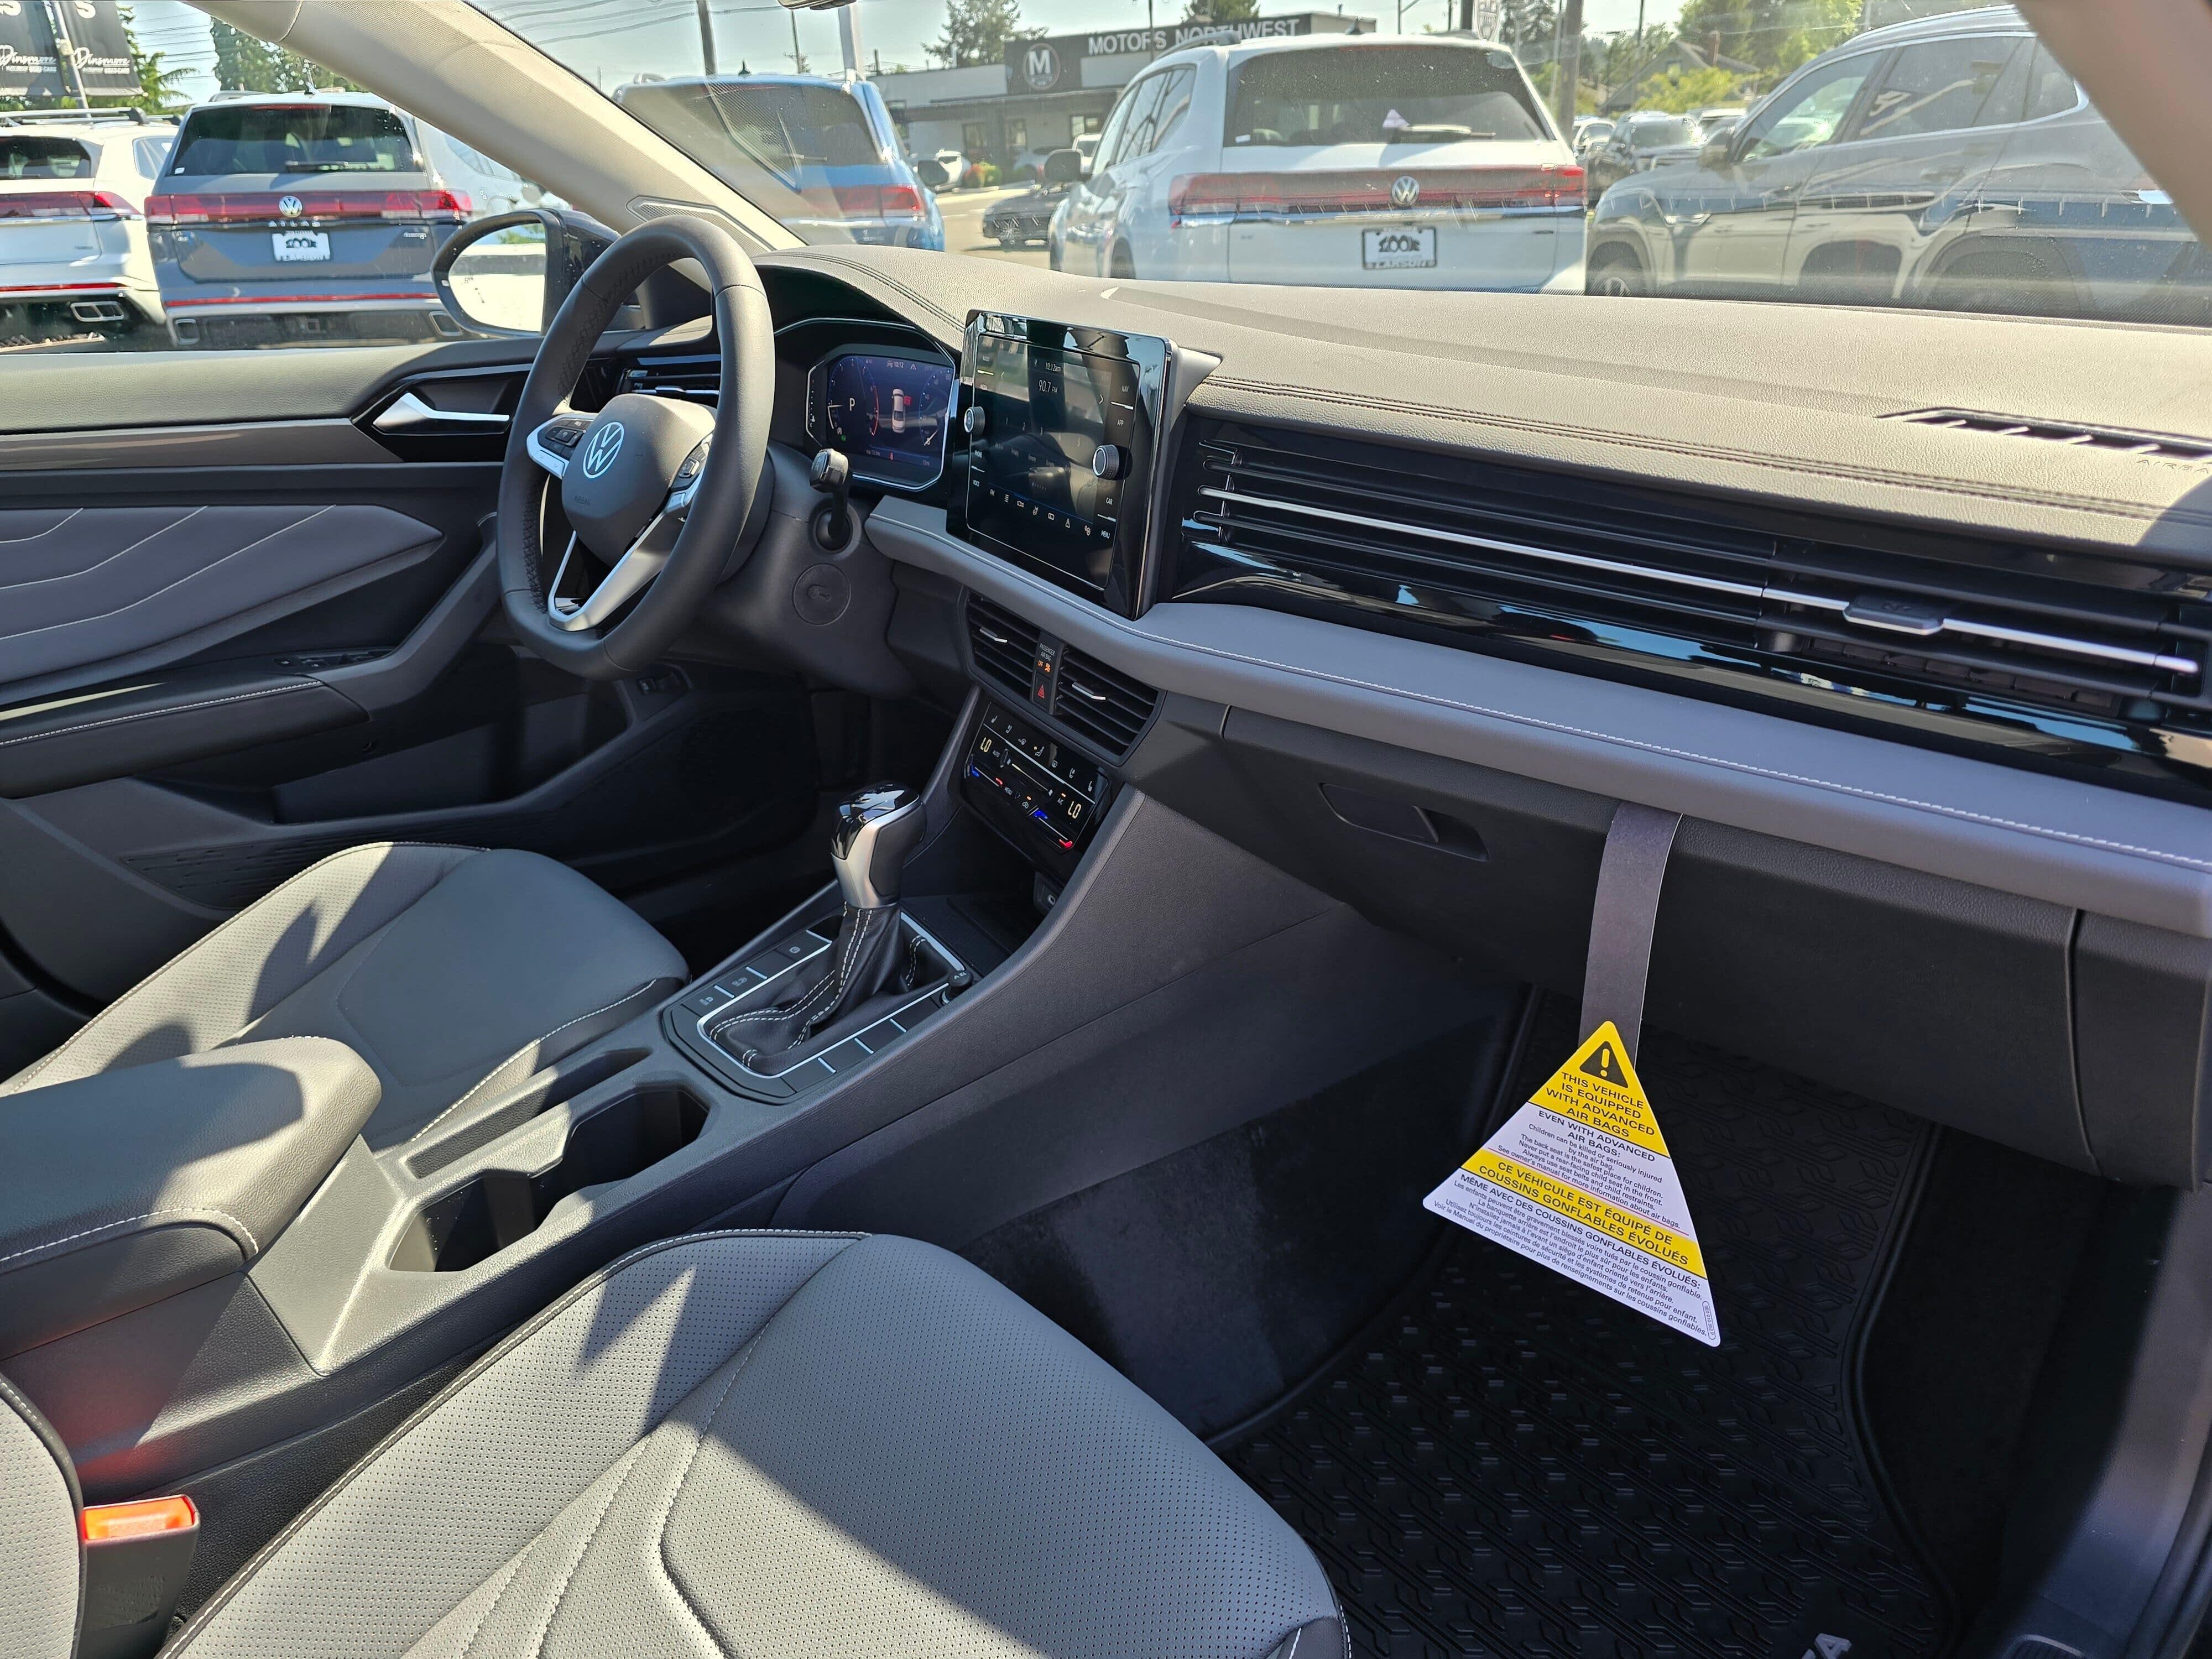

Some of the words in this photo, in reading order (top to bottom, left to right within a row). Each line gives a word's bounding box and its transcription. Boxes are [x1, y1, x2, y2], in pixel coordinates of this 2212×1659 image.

[1029, 49, 1051, 75] M
[849, 398, 855, 411] P
[1039, 379, 1052, 393] 90.7
[1040, 643, 1056, 656] PASSENGER
[980, 737, 992, 753] LO
[1068, 800, 1082, 819] LO
[1546, 1087, 1579, 1107] WITH
[1582, 1103, 1655, 1135] ADVANCED
[1561, 1072, 1589, 1088] THIS
[1593, 1083, 1644, 1109] VEHICLE
[1562, 1082, 1573, 1093] IS
[1577, 1089, 1641, 1119] EQUIPPED
[1538, 1110, 1565, 1126] EVEN
[1568, 1121, 1594, 1138] WITH
[1597, 1134, 1655, 1161] ADVANCED
[1566, 1108, 1589, 1121] AIR
[1593, 1117, 1629, 1137] BAGS
[1567, 1131, 1585, 1144] AIR
[1588, 1139, 1620, 1158] BAGS:
[1519, 1140, 1538, 1152] Never
[1538, 1149, 1550, 1157] put
[1556, 1156, 1590, 1176] rear-facing
[1591, 1172, 1608, 1182] child
[1608, 1179, 1623, 1189] seat
[1624, 1184, 1630, 1192] in
[1632, 1188, 1643, 1197] the
[1644, 1193, 1663, 1206] front.
[1521, 1133, 1533, 1144] The
[1534, 1139, 1549, 1150] back
[1549, 1147, 1563, 1156] seat
[1571, 1155, 1582, 1164] the
[1583, 1161, 1603, 1173] safest
[1603, 1168, 1621, 1181] place
[1623, 1176, 1633, 1185] for
[1634, 1182, 1663, 1199] children.
[1528, 1123, 1555, 1139] Children
[1556, 1136, 1568, 1144] can
[1569, 1140, 1578, 1149] be
[1578, 1144, 1597, 1156] killed
[1606, 1157, 1637, 1173] seriously
[1637, 1168, 1663, 1183] injured
[1568, 1146, 1577, 1156] by
[1578, 1151, 1589, 1160] the
[1600, 1160, 1614, 1171] bag.
[1498, 1145, 1510, 1155] See
[1536, 1162, 1561, 1176] manual
[1561, 1172, 1571, 1181] for
[1572, 1177, 1589, 1189] more
[1590, 1184, 1629, 1206] information
[1630, 1203, 1650, 1215] about
[1661, 1215, 1680, 1229] bags.
[1498, 1162, 1514, 1175] CE
[1516, 1168, 1575, 1202] VÉHICULE
[1578, 1197, 1602, 1212] EST
[1604, 1208, 1651, 1236] ÉQUIPÉ
[1655, 1230, 1673, 1245] DE
[1522, 1149, 1546, 1163] Always
[1546, 1160, 1558, 1168] use
[1558, 1165, 1573, 1175] seat
[1573, 1170, 1589, 1182] belts
[1590, 1179, 1604, 1188] and
[1604, 1185, 1621, 1195] child
[1621, 1192, 1655, 1211] restraints.
[1454, 1180, 1465, 1190] Les
[1465, 1187, 1488, 1200] enfants
[1488, 1197, 1513, 1212] peuvent
[1513, 1207, 1526, 1218] être
[1526, 1215, 1561, 1234] gravement
[1561, 1229, 1585, 1245] blessés
[1587, 1242, 1603, 1254] voire
[1604, 1250, 1619, 1261] tués
[1619, 1258, 1632, 1267] par
[1632, 1262, 1639, 1270] le
[1640, 1267, 1667, 1284] coussin
[1667, 1280, 1702, 1300] gonflable.
[1460, 1173, 1489, 1192] MÊME
[1489, 1188, 1514, 1203] AVEC
[1515, 1198, 1533, 1212] DES
[1535, 1208, 1583, 1235] COUSSINS
[1585, 1231, 1650, 1265] GONFLABLES
[1651, 1260, 1700, 1289] ÉVOLUÉS:
[1479, 1166, 1540, 1198] COUSSINS
[1543, 1194, 1625, 1236] GONFLABLES
[1628, 1231, 1688, 1265] ÉVOLUÉS
[1434, 1200, 1447, 1211] Voir
[1453, 1209, 1475, 1225] Manuel
[1475, 1221, 1484, 1229] du
[1484, 1226, 1520, 1246] propriétaire
[1520, 1243, 1536, 1254] pour
[1536, 1251, 1551, 1261] plus
[1561, 1262, 1613, 1291] renseignements
[1613, 1288, 1626, 1296] sur
[1626, 1292, 1636, 1302] les
[1637, 1299, 1667, 1317] coussins
[1668, 1314, 1707, 1336] gonflables.
[1446, 1198, 1467, 1213] Utilisez
[1468, 1209, 1493, 1225] toujours
[1493, 1220, 1503, 1230] les
[1503, 1227, 1531, 1244] ceintures
[1541, 1245, 1567, 1260] sécurité
[1575, 1260, 1585, 1269] les
[1585, 1266, 1617, 1285] systèmes
[1618, 1281, 1626, 1289] de
[1627, 1286, 1654, 1302] retenue
[1654, 1299, 1672, 1310] pour
[1673, 1308, 1697, 1323] enfant.
[1499, 1218, 1521, 1231] jamais
[1558, 1245, 1576, 1257] siège
[1605, 1267, 1629, 1282] orienté
[1630, 1279, 1645, 1289] vers
